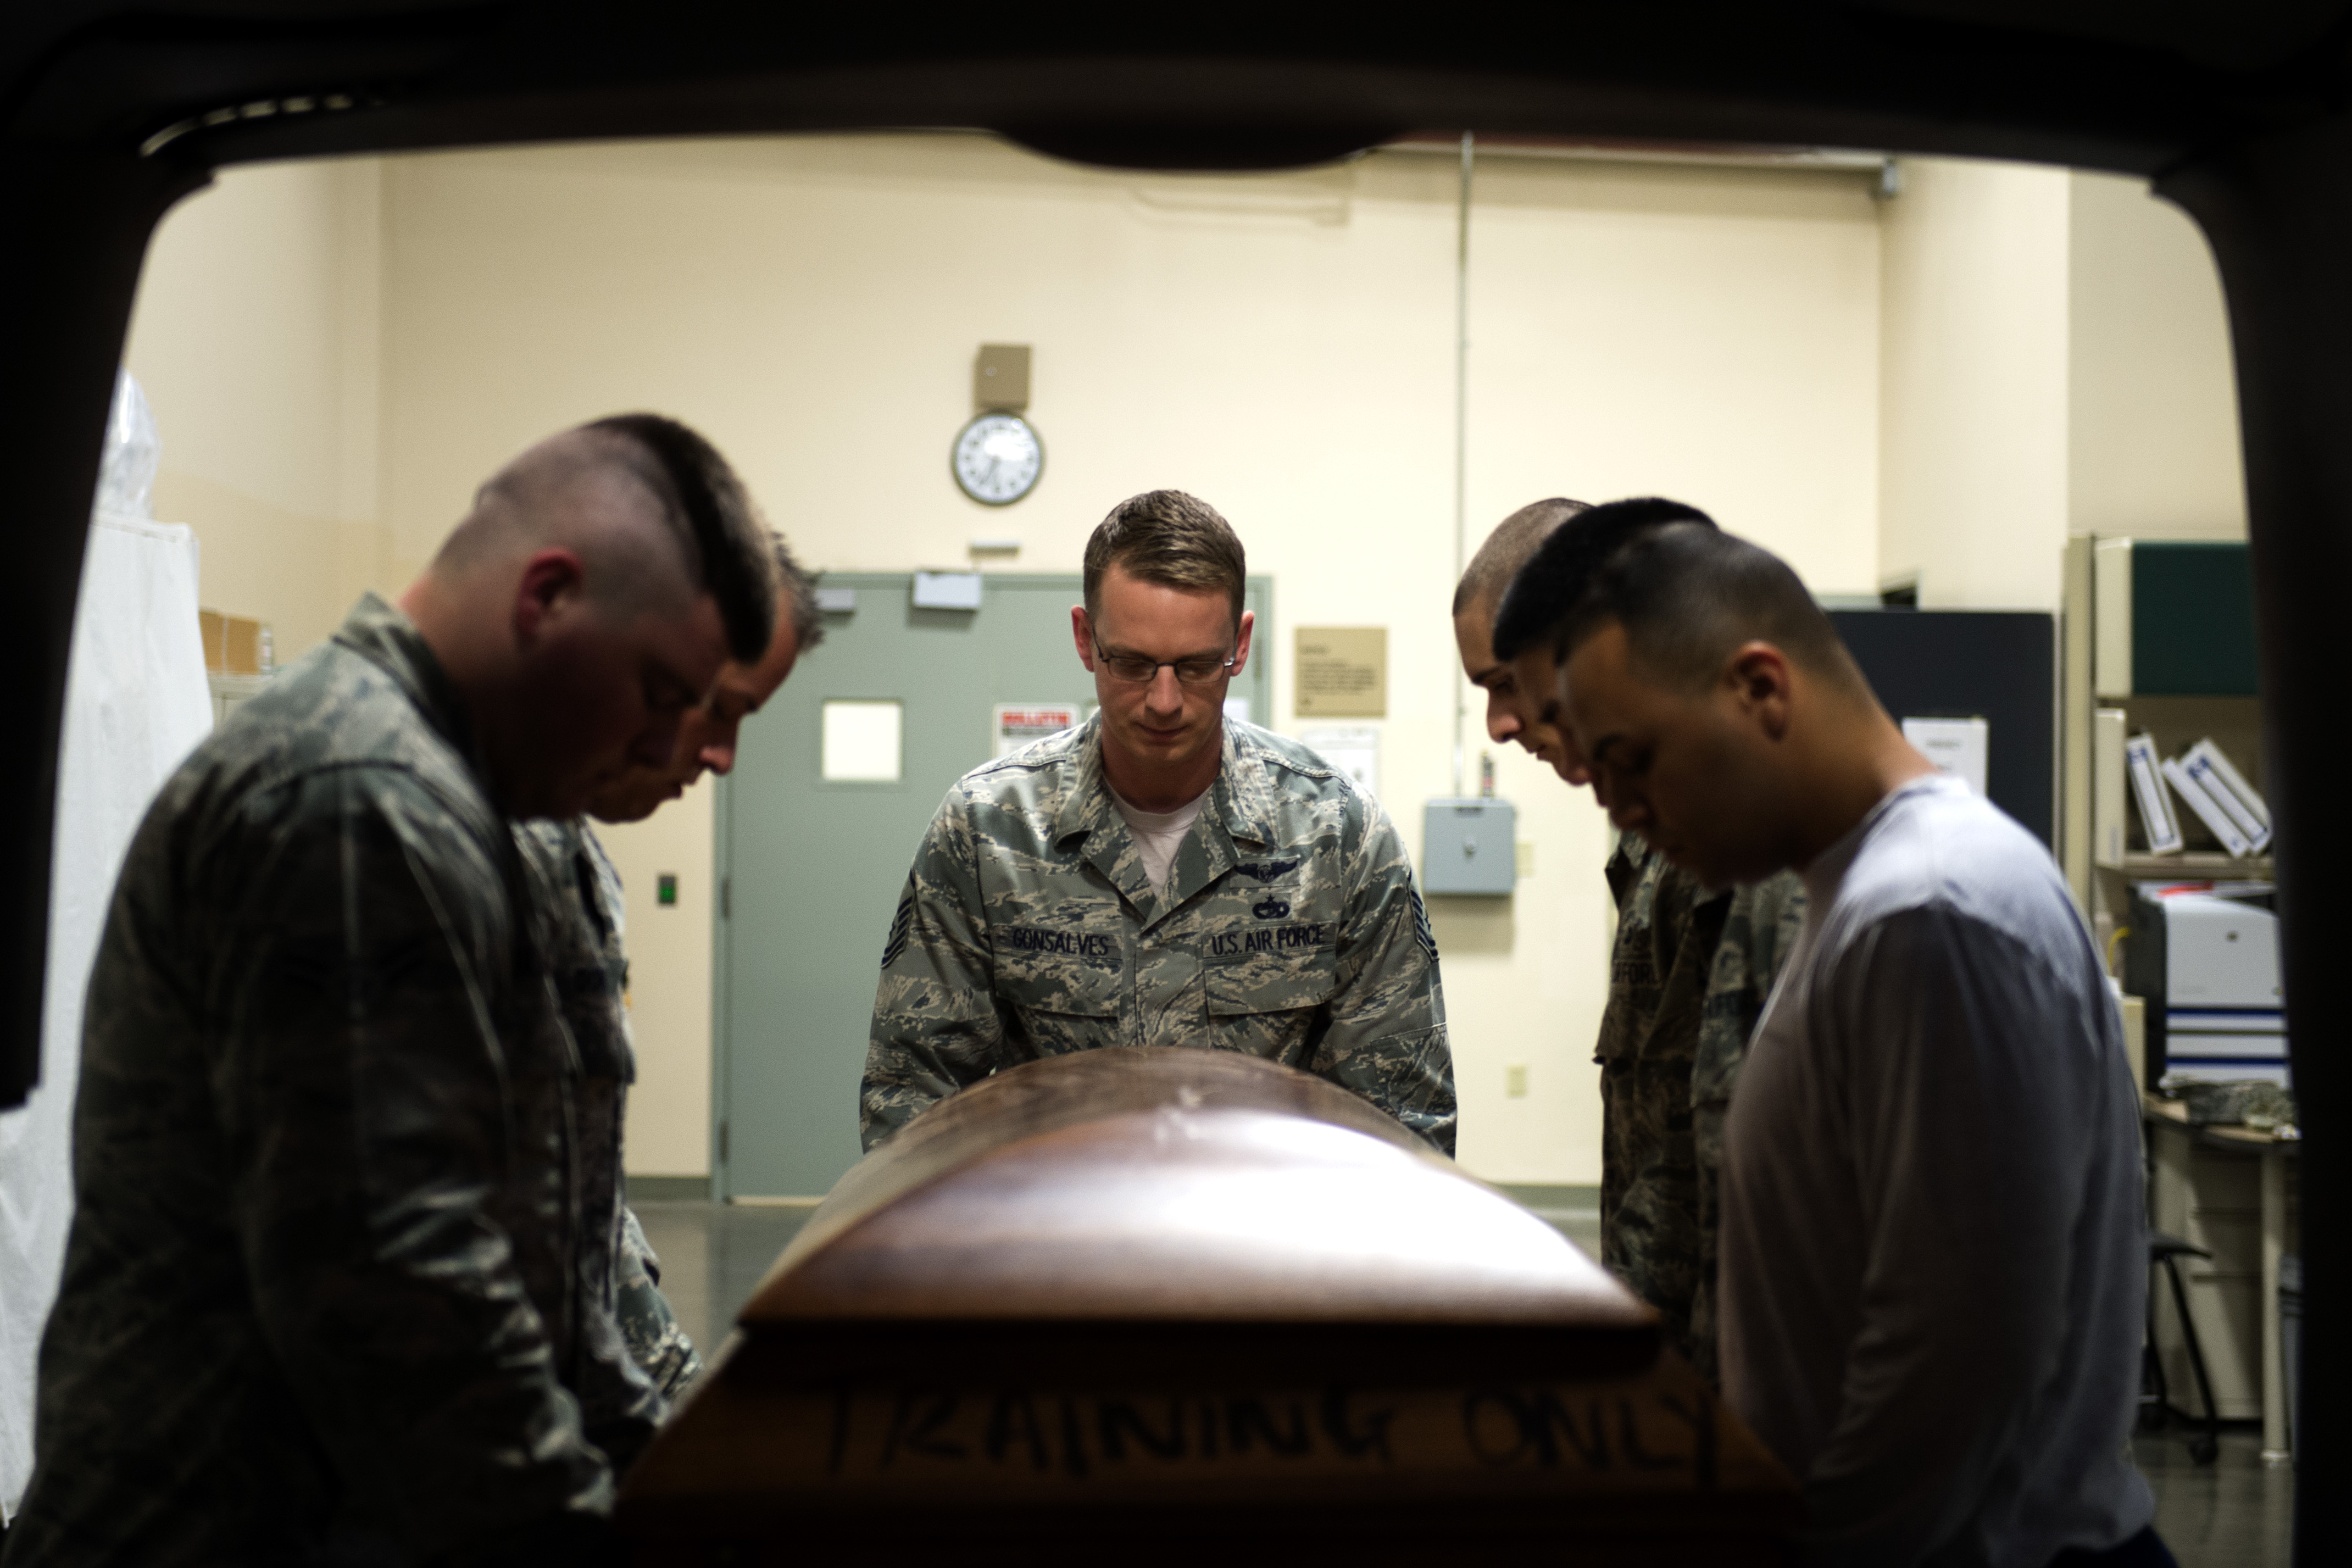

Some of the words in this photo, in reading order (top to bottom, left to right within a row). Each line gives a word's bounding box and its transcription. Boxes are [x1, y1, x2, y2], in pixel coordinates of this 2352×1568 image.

[1013, 928, 1109, 956] GONSALVES
[1212, 935, 1243, 955] U.S.
[1244, 930, 1274, 952] AIR
[1277, 924, 1325, 949] FORCE
[808, 1374, 1397, 1478] TRAINING
[1464, 1379, 1719, 1492] ONLY
